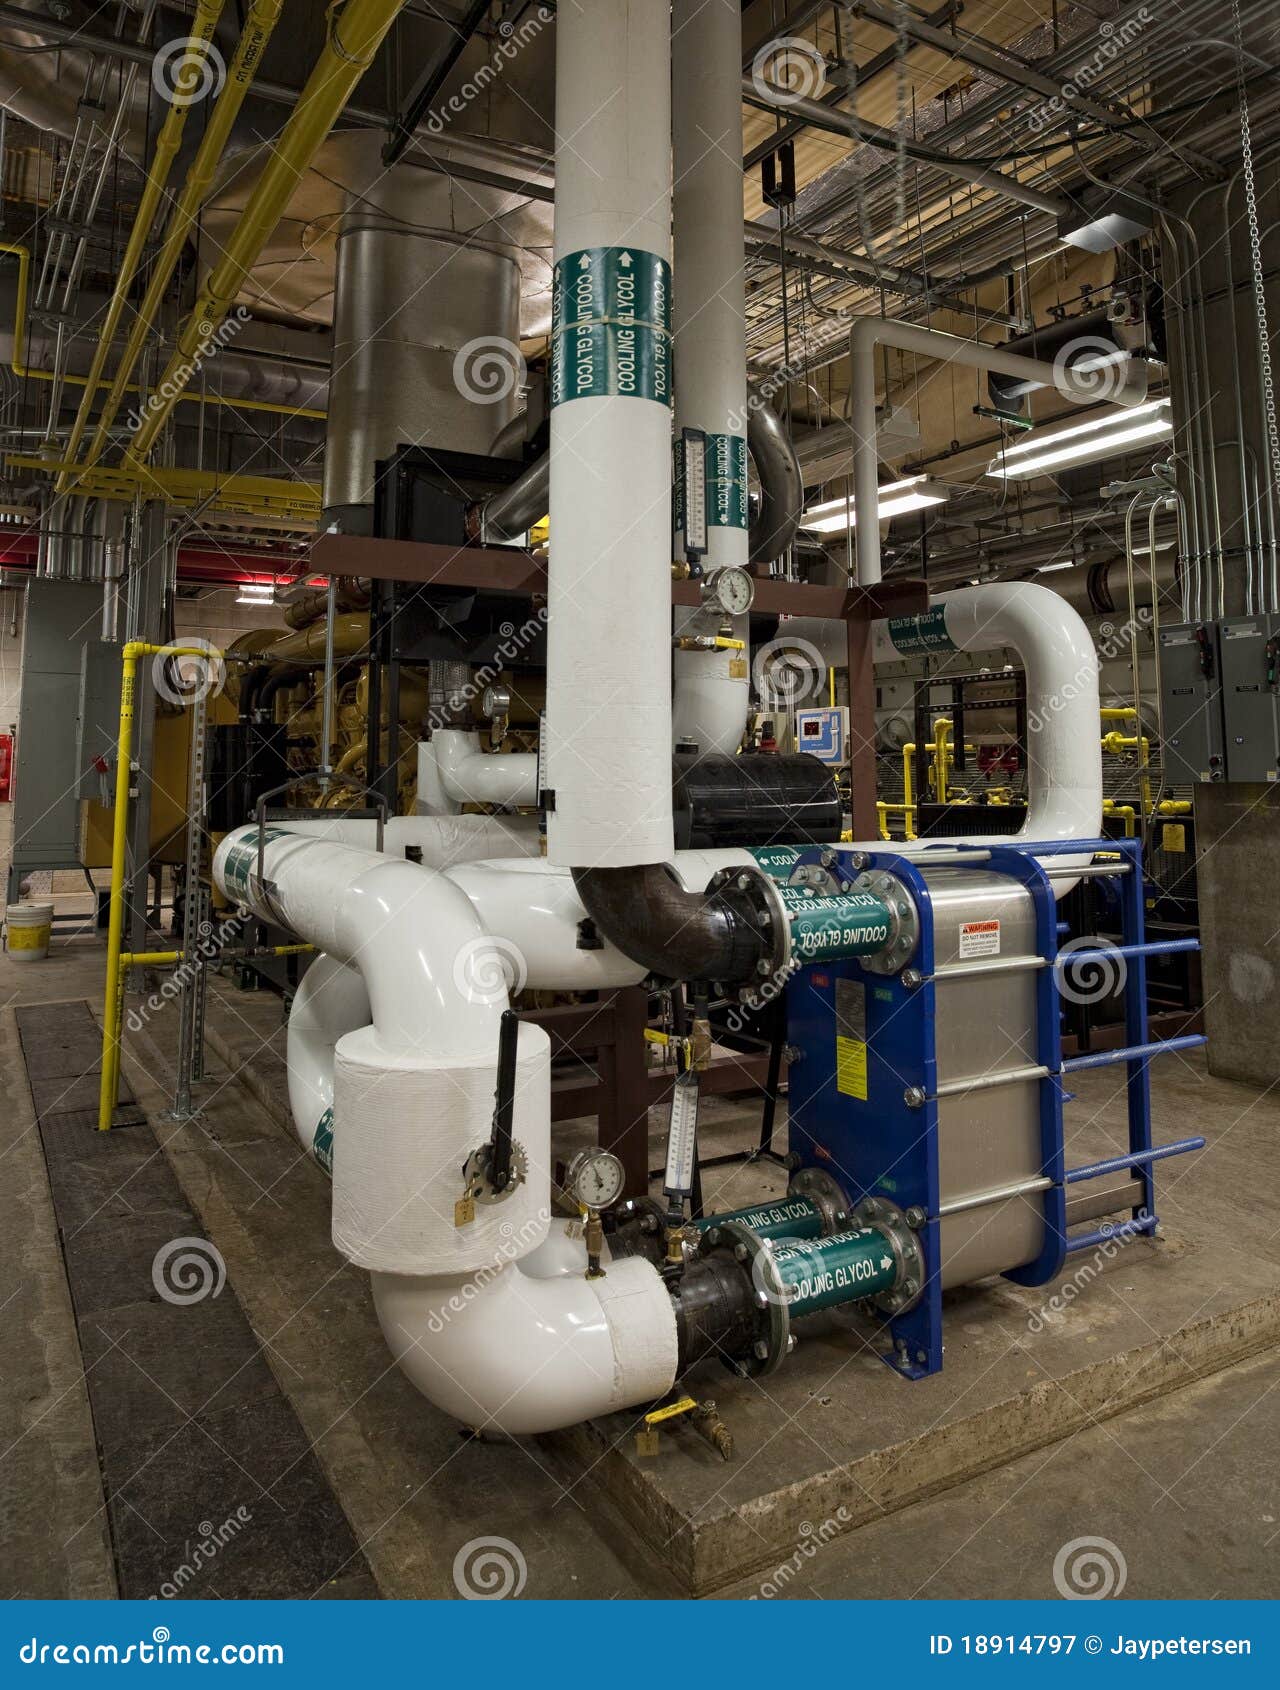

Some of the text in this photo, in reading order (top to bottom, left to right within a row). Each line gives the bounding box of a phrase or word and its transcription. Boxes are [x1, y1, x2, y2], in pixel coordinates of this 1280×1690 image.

[552, 284, 562, 403] COOLING GLYCOL
[576, 274, 594, 394] COOLING GLYCOL
[617, 272, 636, 392] COOLING GLYCOL
[654, 280, 666, 398] COOLING GLYCOL
[716, 436, 730, 511] COOLING GLYCOL
[738, 440, 746, 514] COOLING GLYCOL
[779, 887, 803, 900] COL
[788, 894, 881, 912] COOLING GLYCOL
[800, 925, 887, 949] COOLING GLYCOL
[720, 1202, 814, 1230] OLING GLYCOL
[772, 1243, 810, 1262] GLYCO
[808, 1229, 861, 1250] COOLING
[788, 1258, 879, 1303] OOLING GLYCOL
